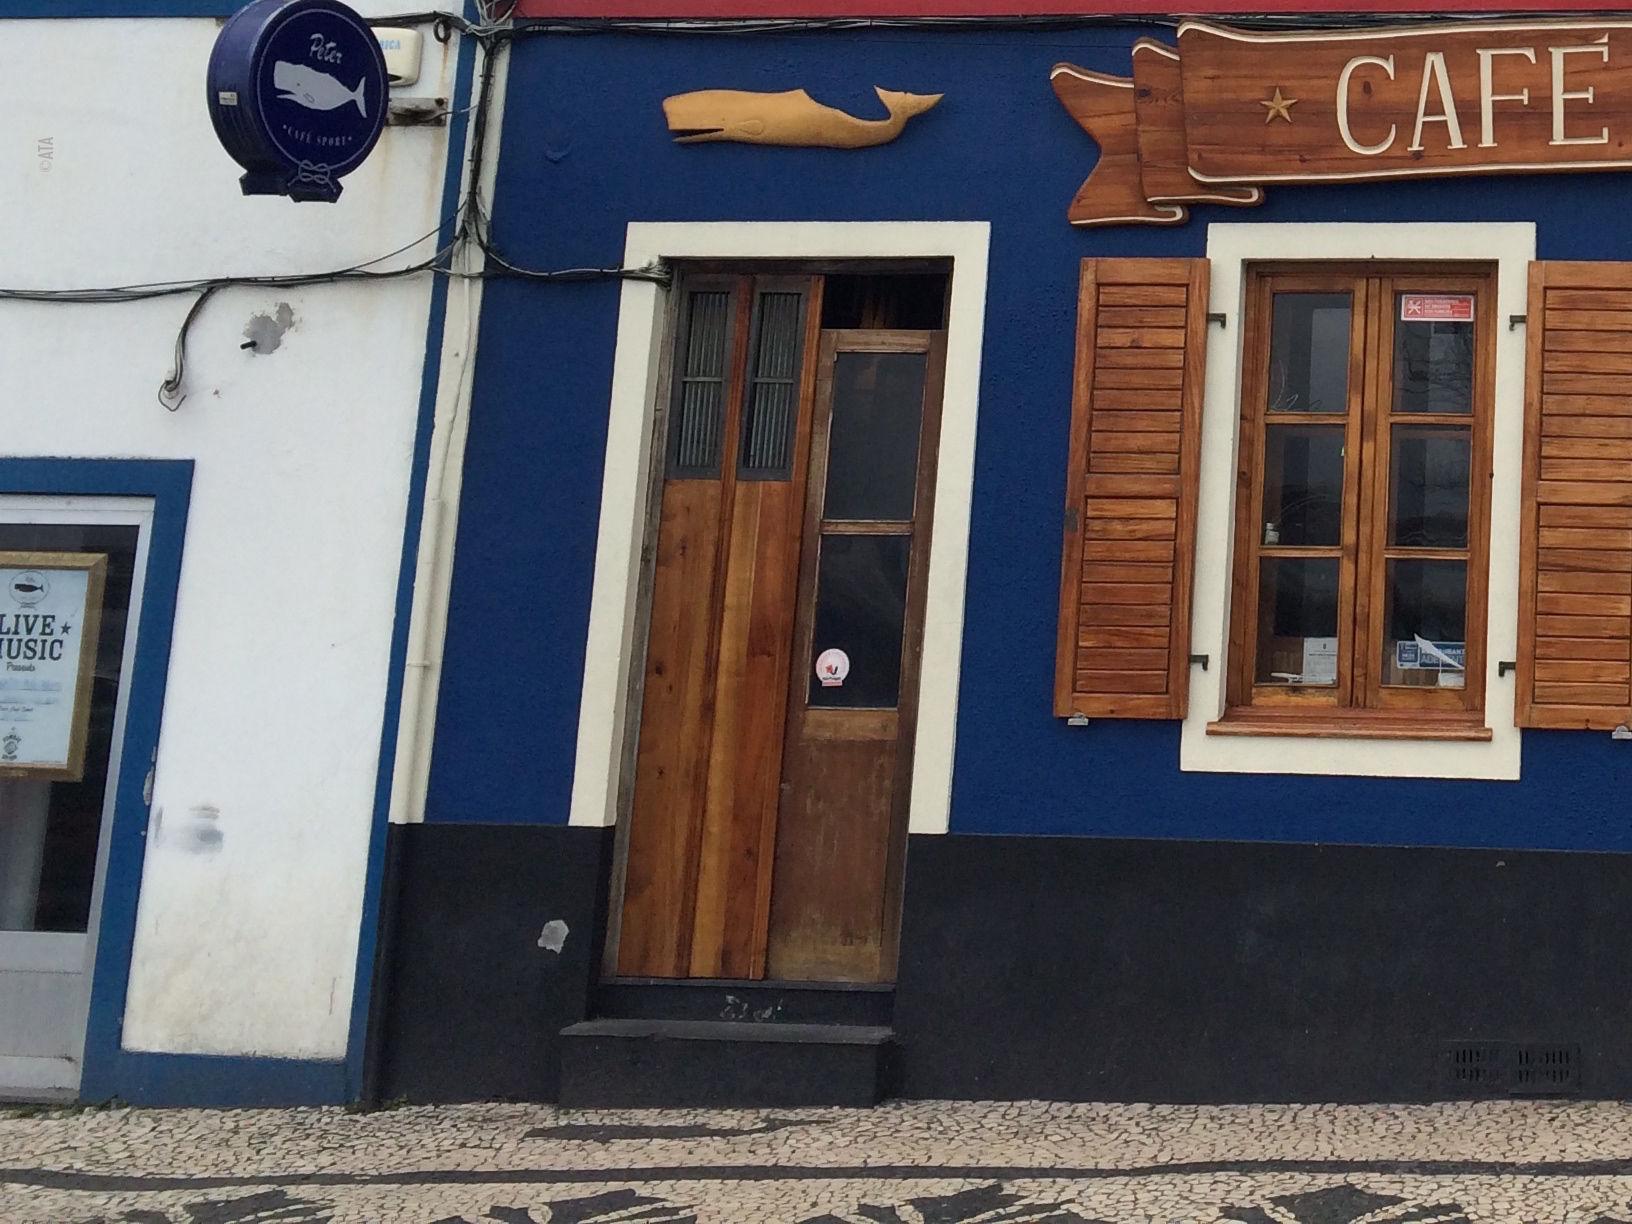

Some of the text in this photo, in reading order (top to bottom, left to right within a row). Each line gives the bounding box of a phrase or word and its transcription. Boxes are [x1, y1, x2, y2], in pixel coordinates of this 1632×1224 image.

[310, 33, 342, 64] Peter
[1336, 33, 1608, 155] CAFÉ
[0, 614, 55, 636] LIVE
